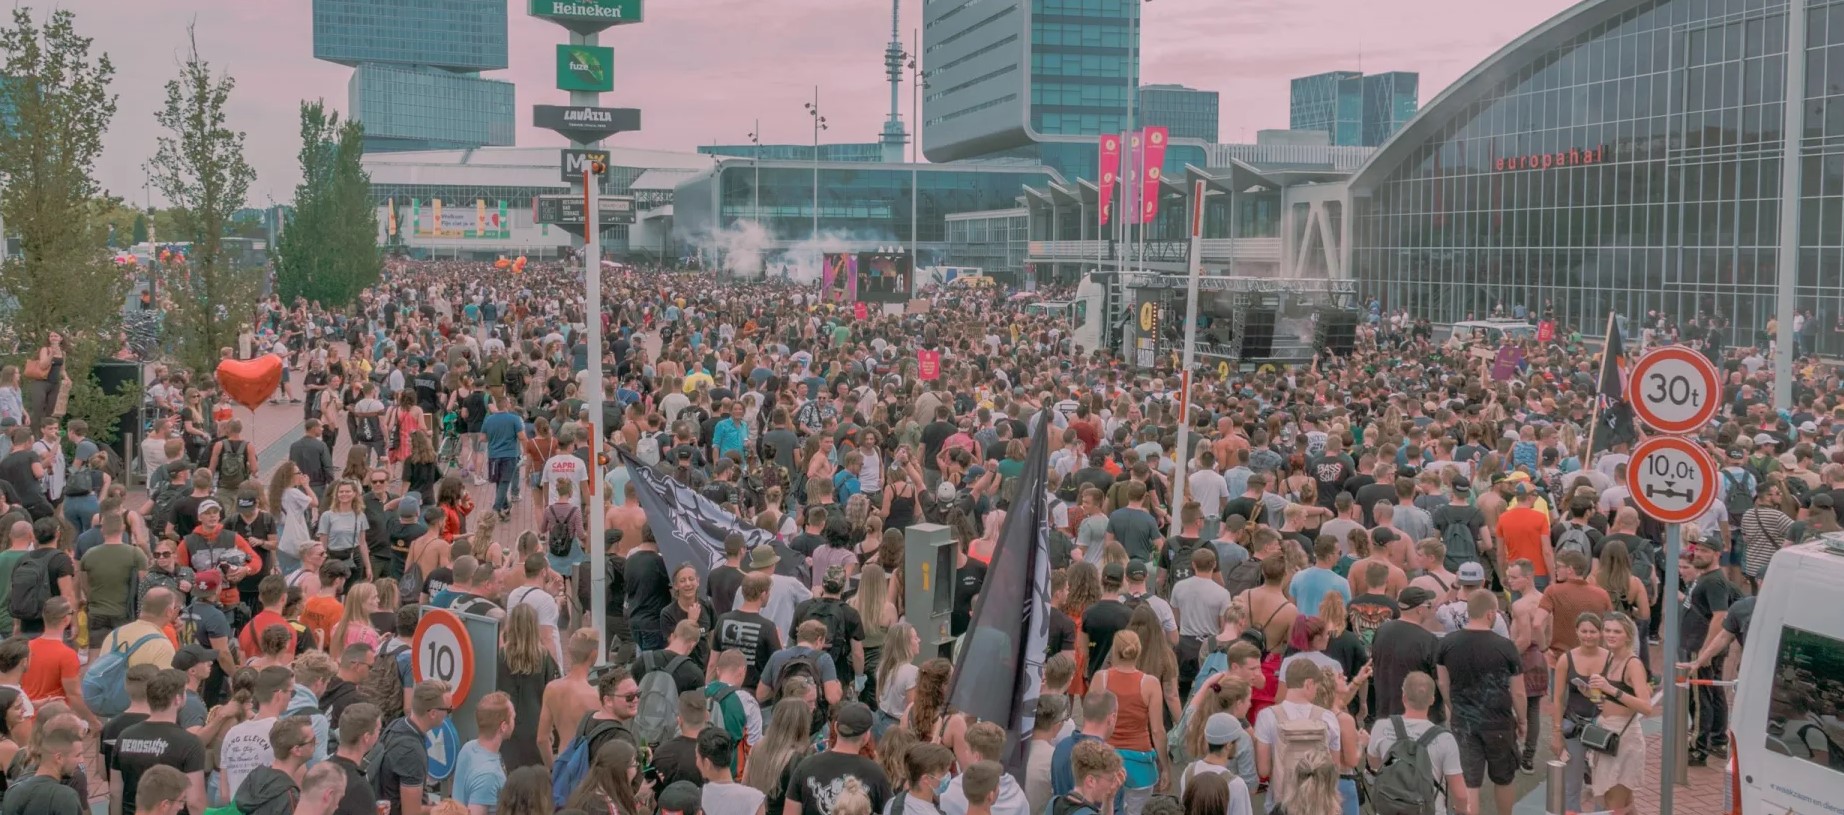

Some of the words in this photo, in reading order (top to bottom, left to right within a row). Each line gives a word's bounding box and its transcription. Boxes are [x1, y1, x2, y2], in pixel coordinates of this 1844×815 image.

[552, 2, 621, 17] Heineken
[569, 61, 589, 70] fuze
[564, 108, 612, 122] LAVAZZA
[1496, 144, 1602, 171] europahal
[1647, 373, 1699, 407] 30t
[1648, 454, 1694, 480] 10,0t
[429, 641, 455, 682] 10
